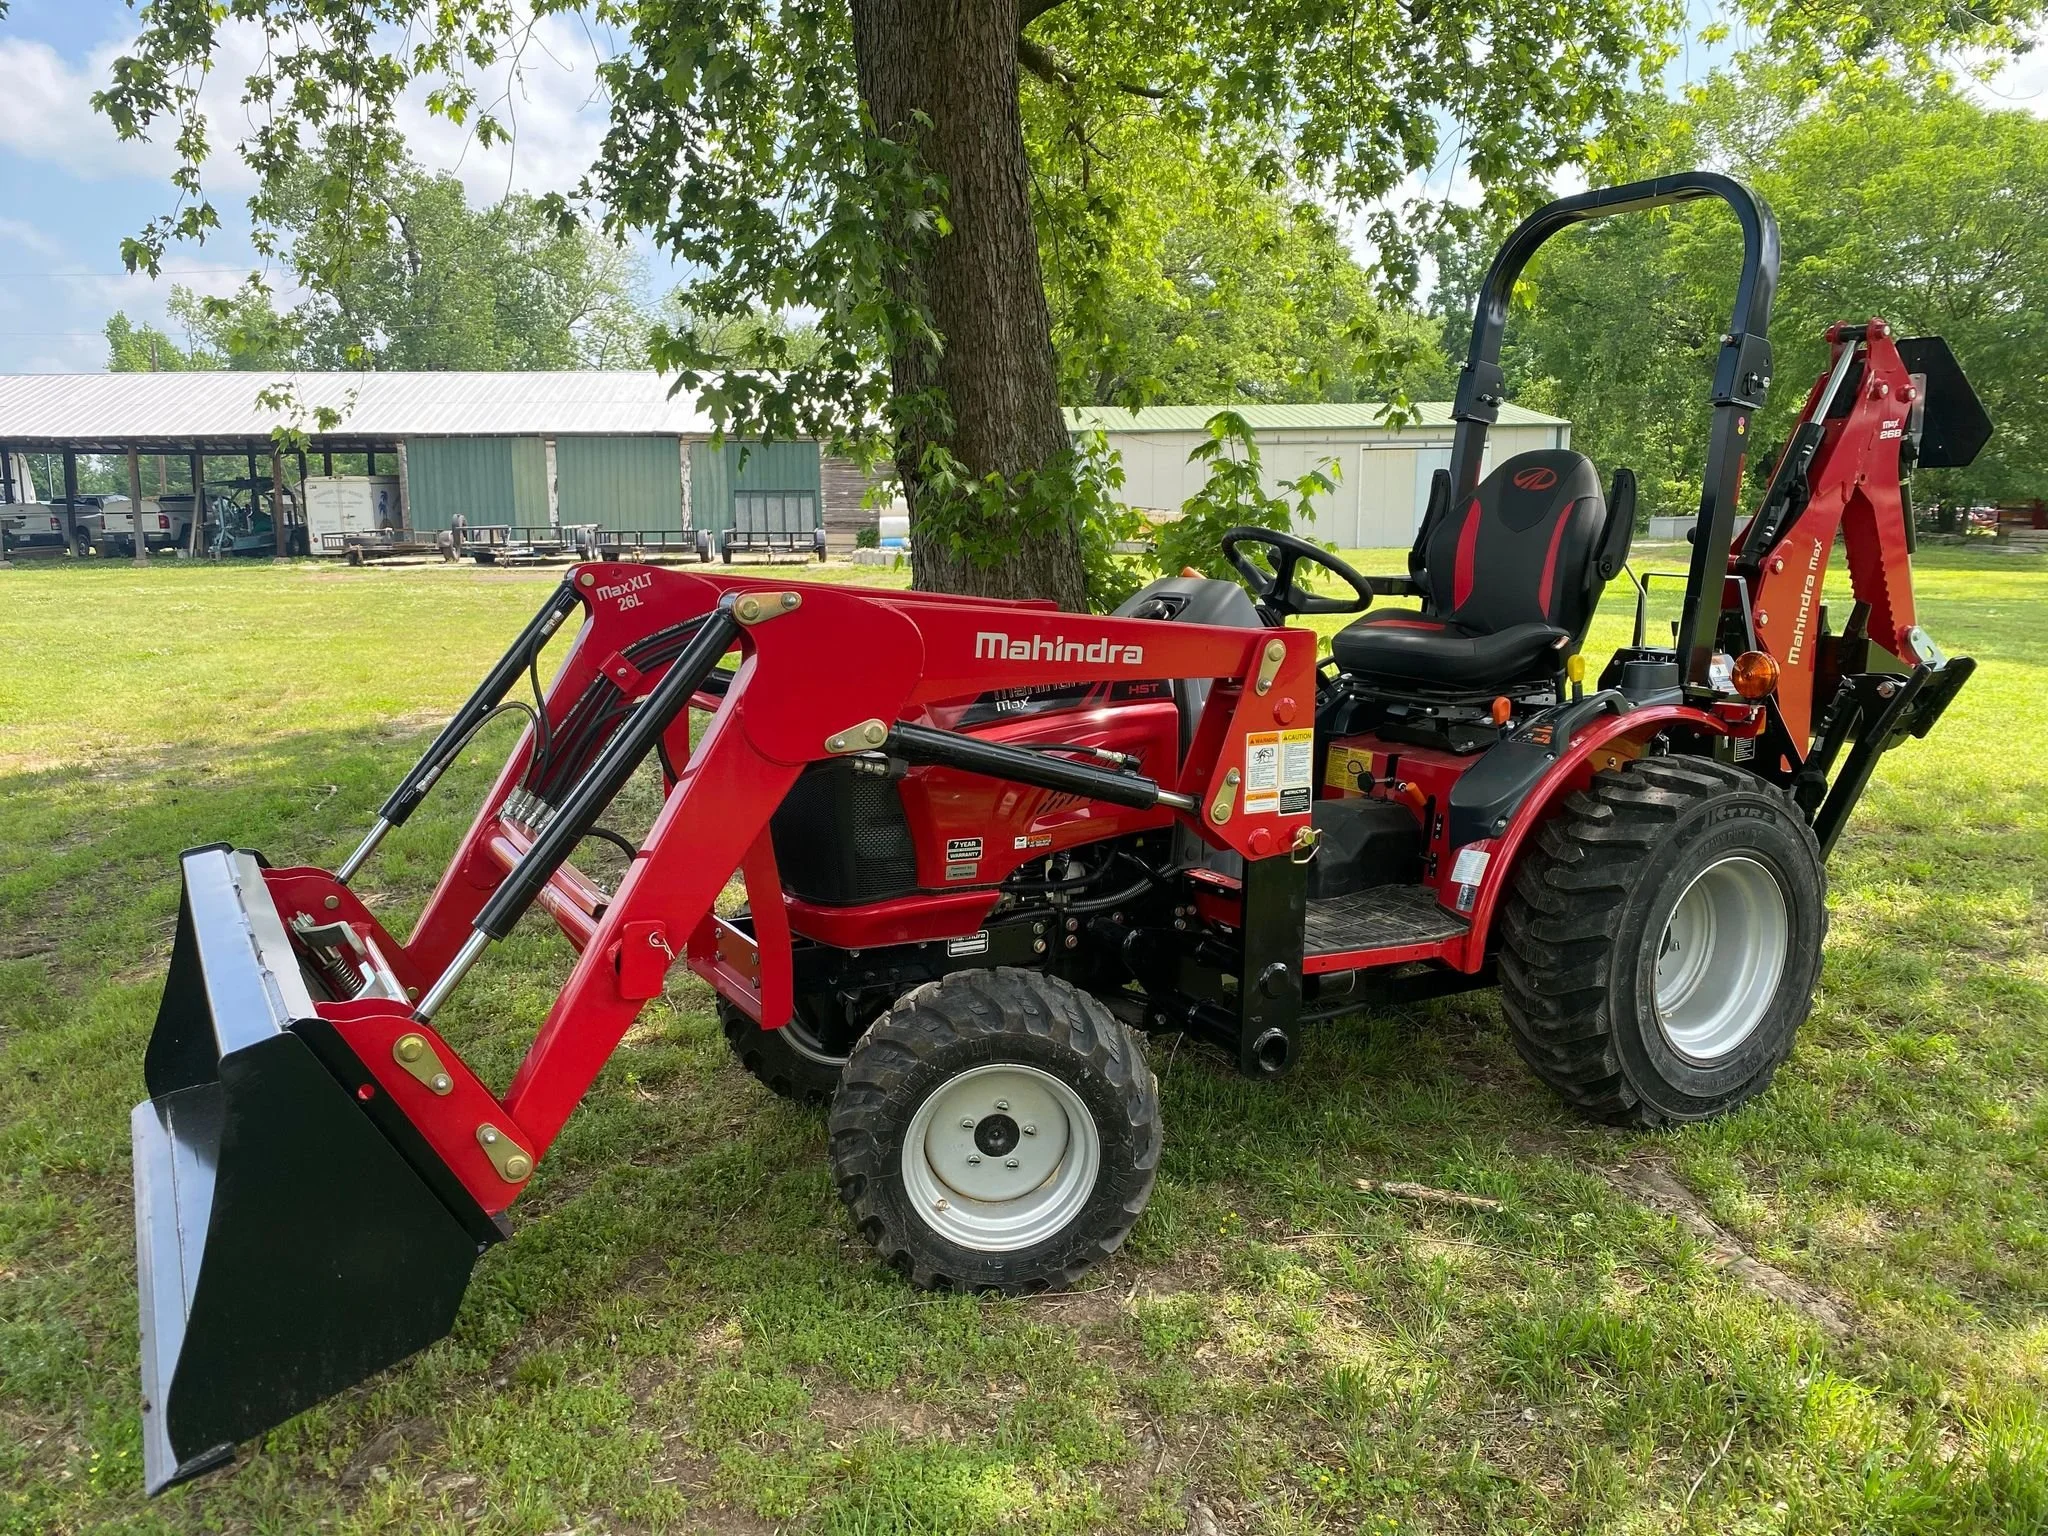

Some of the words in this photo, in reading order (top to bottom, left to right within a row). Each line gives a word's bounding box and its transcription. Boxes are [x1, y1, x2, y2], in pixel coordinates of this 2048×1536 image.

[617, 594, 644, 612] 26L
[1787, 574, 1816, 665] Mahindra
[975, 631, 1144, 665] Mahindra
[1128, 683, 1160, 695] HST
[1255, 736, 1279, 744] WARNING
[1287, 733, 1312, 741] CAUTION
